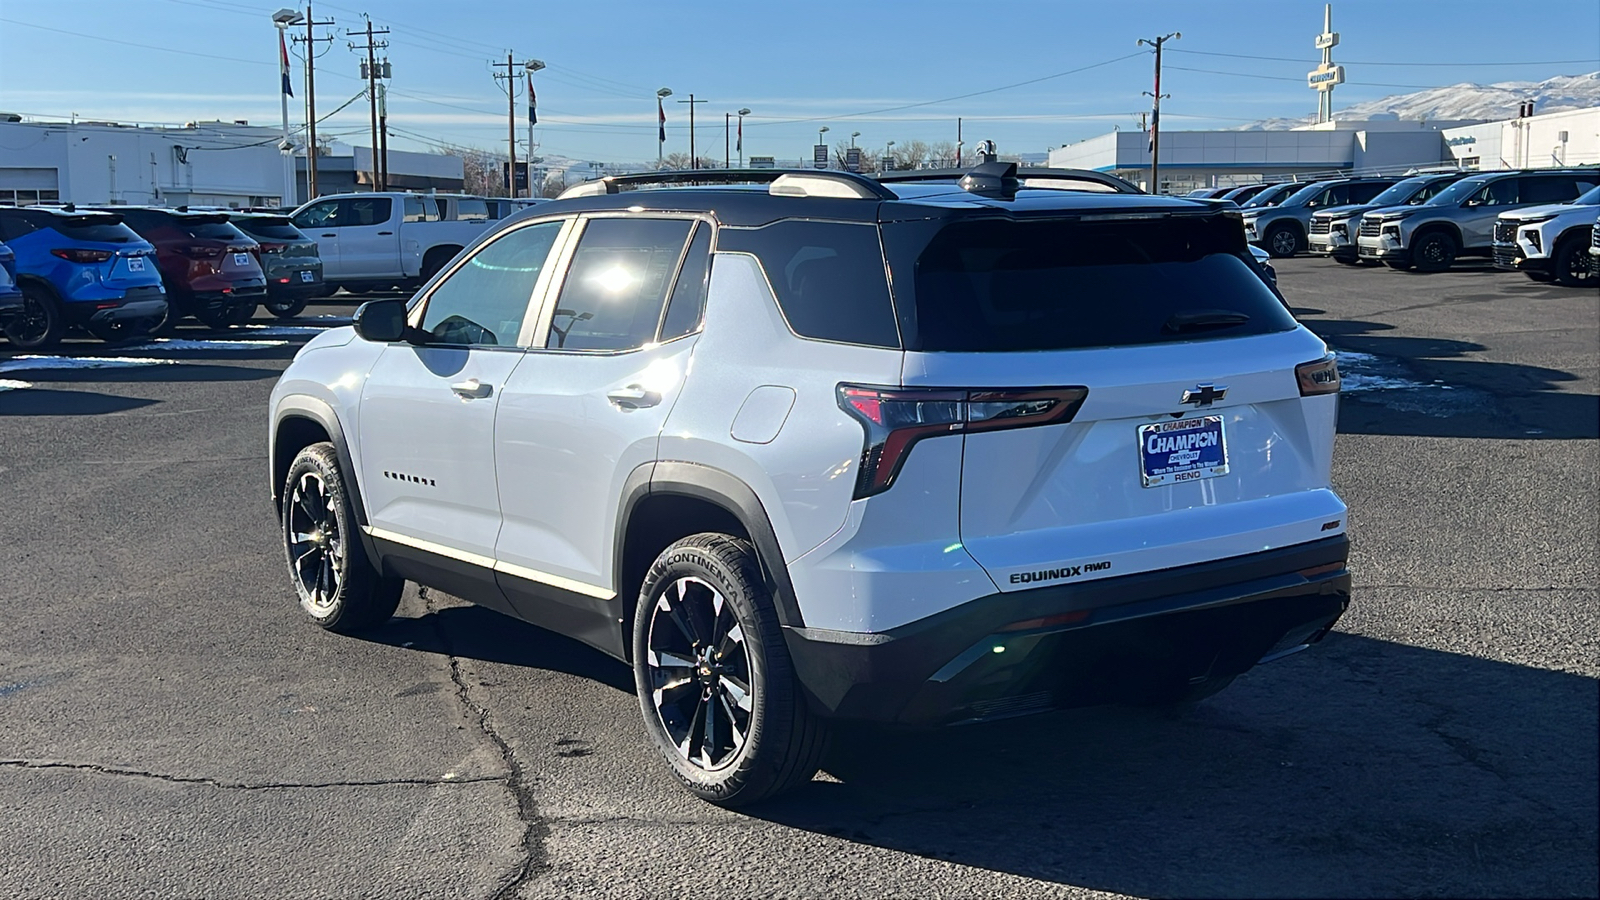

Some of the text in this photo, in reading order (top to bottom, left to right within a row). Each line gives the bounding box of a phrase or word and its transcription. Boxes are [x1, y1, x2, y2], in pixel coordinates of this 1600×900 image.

[1163, 419, 1202, 431] CHAMPION
[1147, 431, 1218, 454] CHAMPION
[1170, 452, 1198, 461] CHEVROLET
[1175, 471, 1201, 481] RENO
[1010, 561, 1111, 584] EQUINOX AWD
[667, 553, 748, 620] CONTINENTAL
